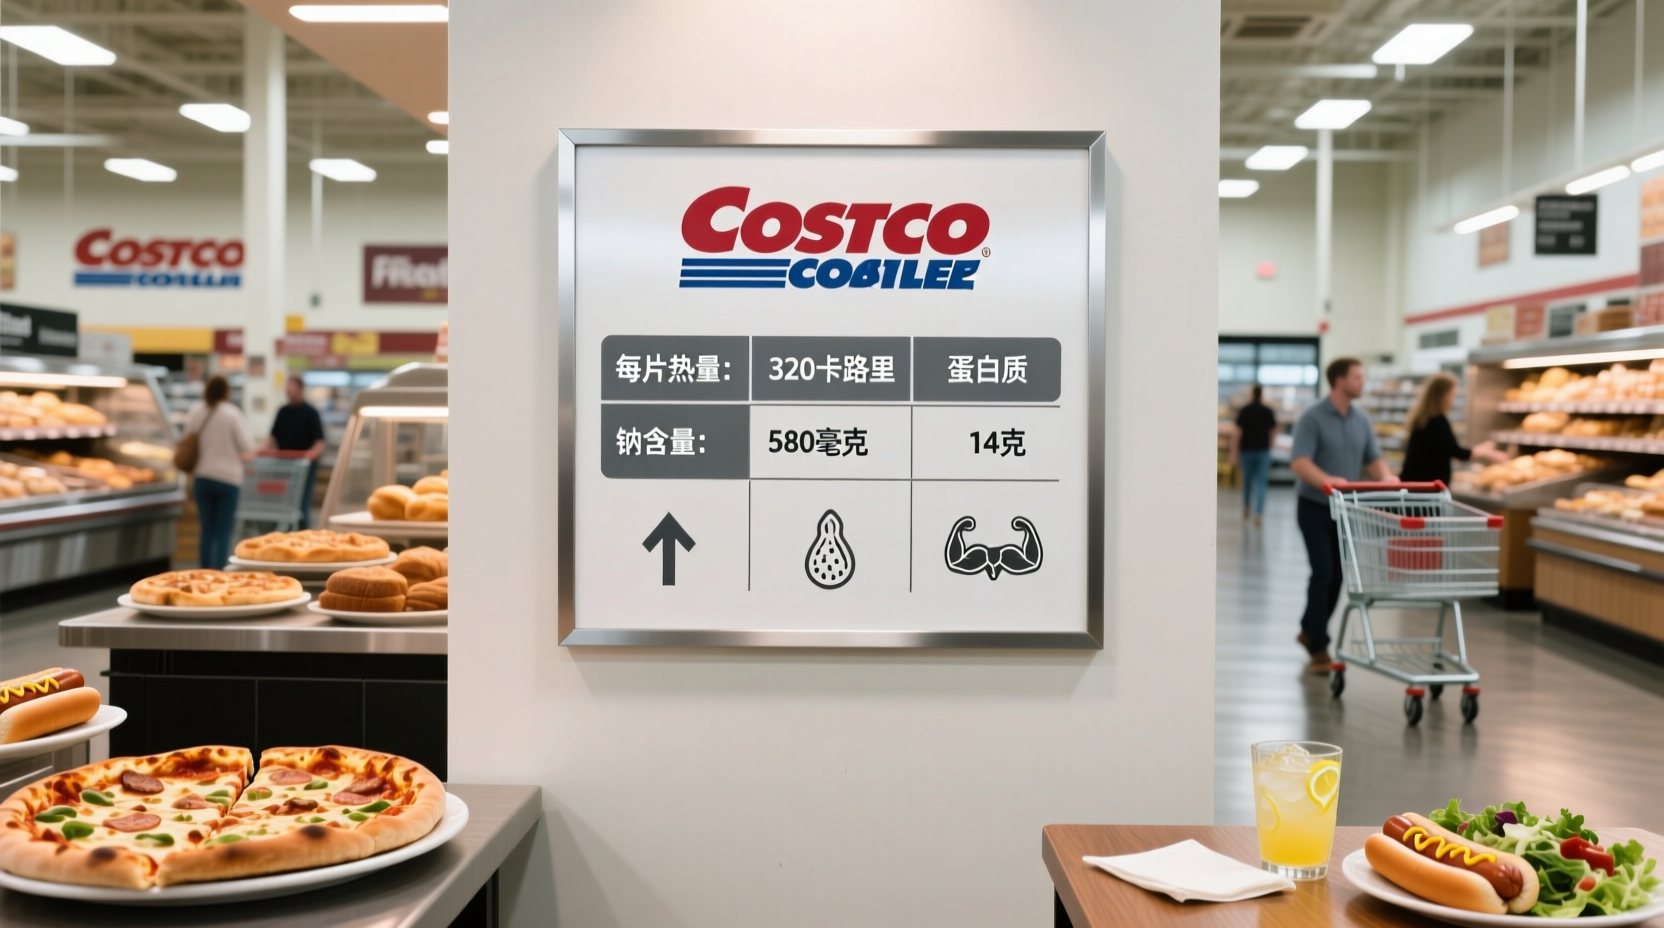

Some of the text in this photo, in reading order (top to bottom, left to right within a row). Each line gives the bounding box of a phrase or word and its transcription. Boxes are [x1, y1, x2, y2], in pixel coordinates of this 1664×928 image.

[681, 186, 990, 255] COSTCO
[74, 229, 244, 268] COSTCO
[615, 353, 1028, 384] 每片热量： 320卡路里 蛋白质
[616, 426, 1027, 457] 钠含量： 580毫克 14克
